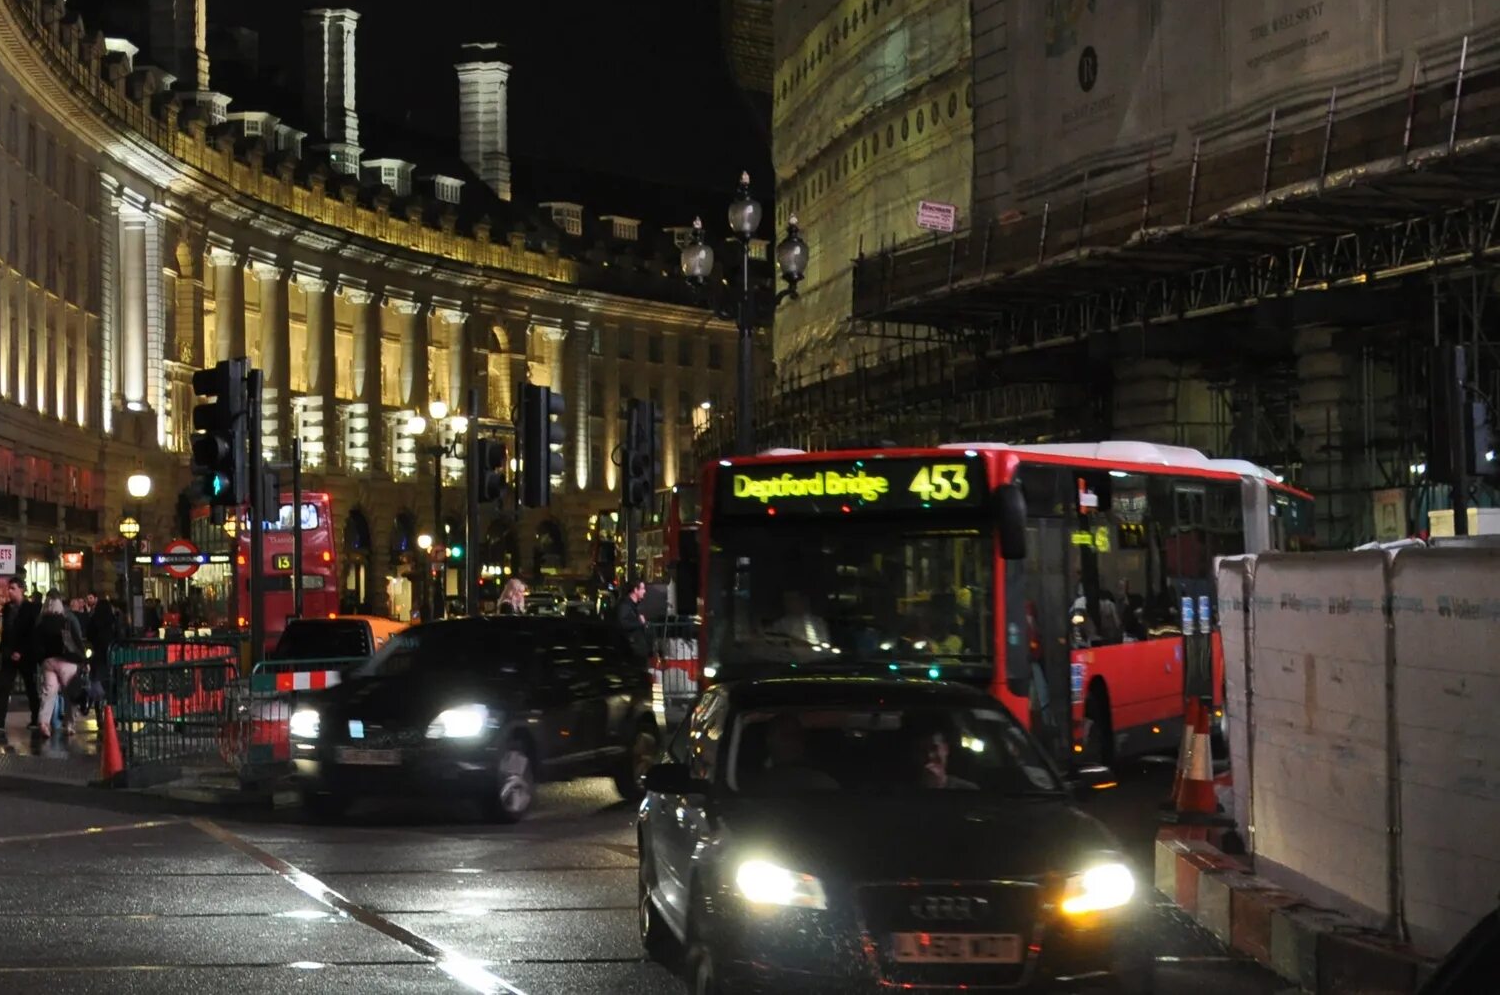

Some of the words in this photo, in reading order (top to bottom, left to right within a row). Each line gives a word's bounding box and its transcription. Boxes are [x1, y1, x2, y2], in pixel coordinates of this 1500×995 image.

[734, 472, 824, 503] Deptford
[825, 470, 889, 501] Bridge
[908, 464, 970, 500] 453
[278, 556, 290, 569] 13
